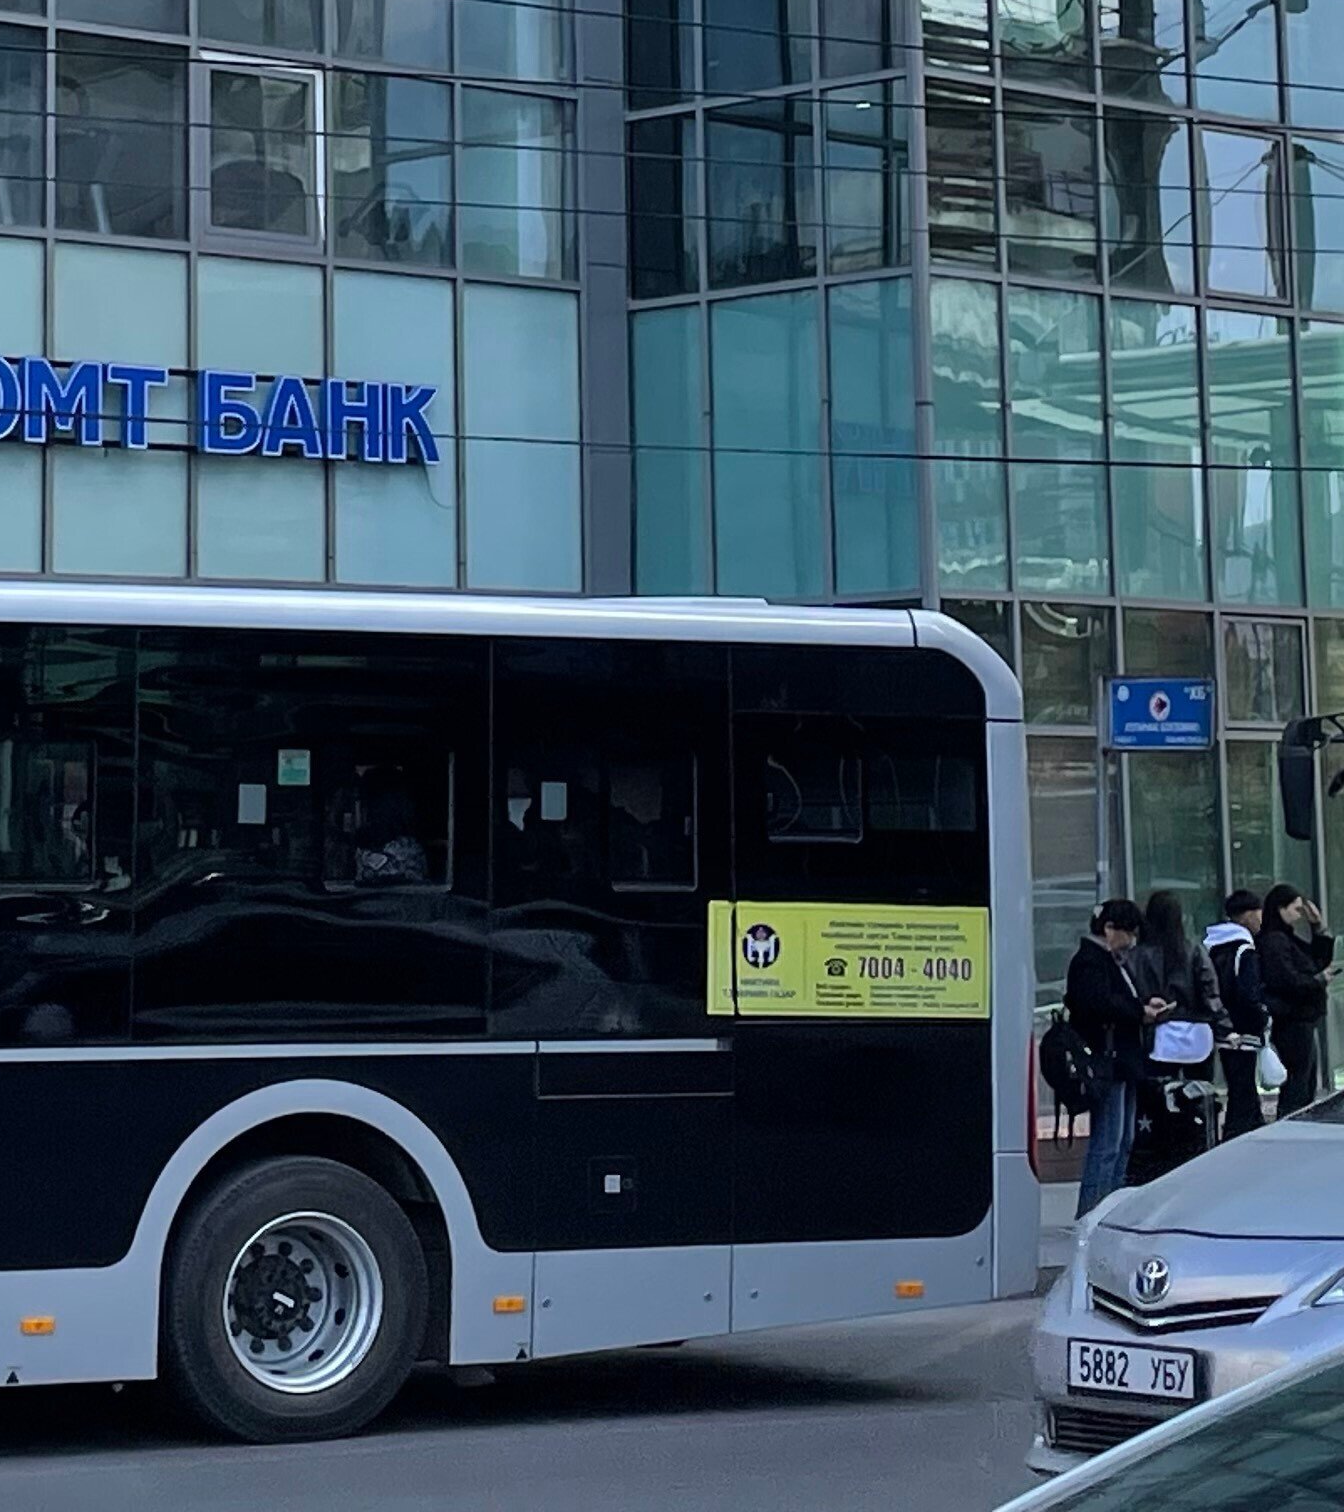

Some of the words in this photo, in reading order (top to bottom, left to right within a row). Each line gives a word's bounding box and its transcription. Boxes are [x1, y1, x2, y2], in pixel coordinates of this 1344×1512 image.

[197, 368, 439, 464] БАНК
[858, 956, 905, 979] 7004
[922, 958, 972, 981] 4040
[1079, 1346, 1129, 1388] 5882
[1150, 1357, 1189, 1392] УБУ
